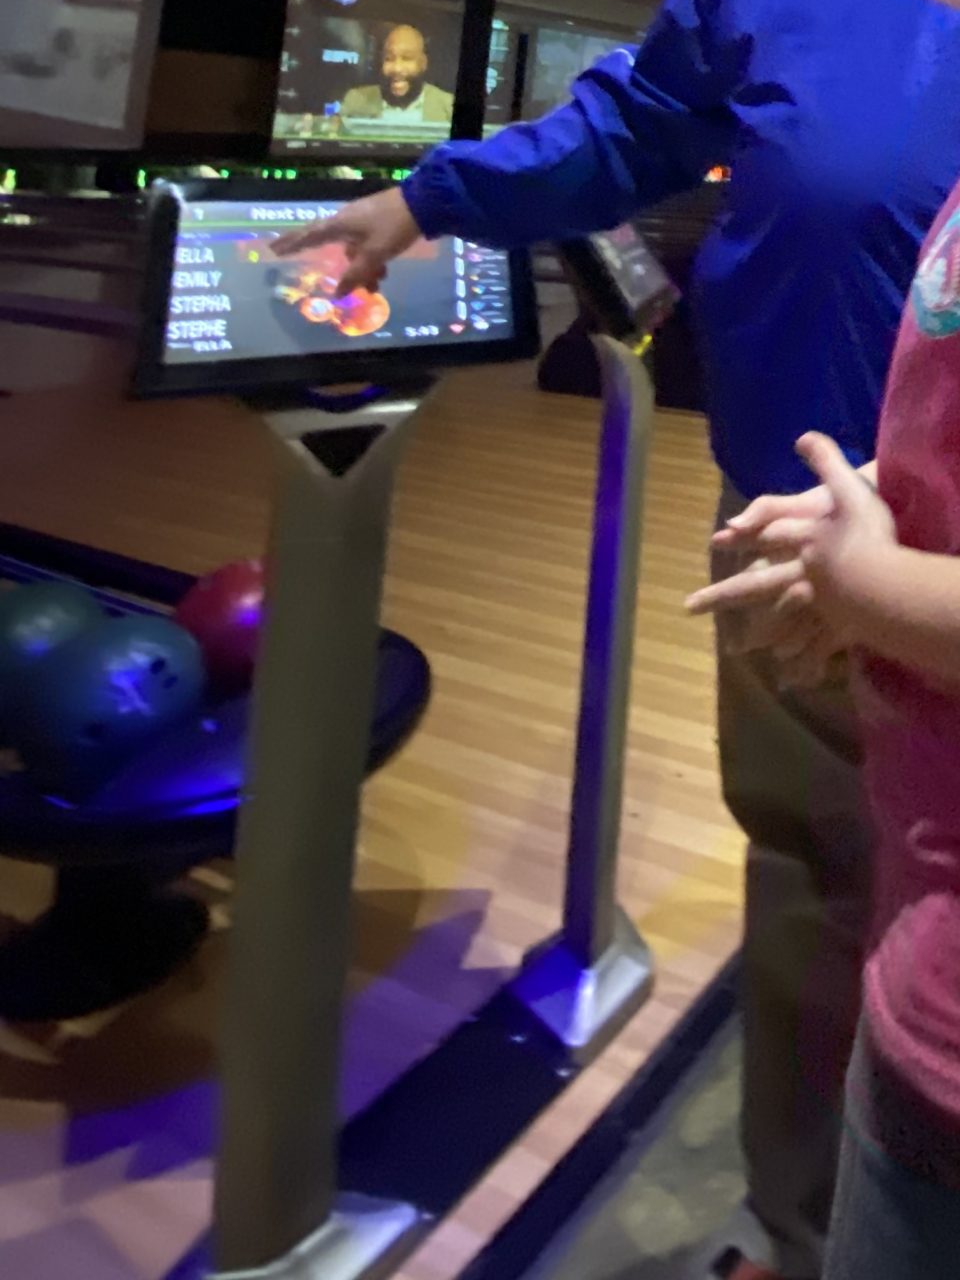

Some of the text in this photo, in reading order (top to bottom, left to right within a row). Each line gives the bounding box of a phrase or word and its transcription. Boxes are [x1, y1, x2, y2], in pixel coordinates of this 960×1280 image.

[251, 207, 296, 221] Next
[296, 206, 317, 221] to
[174, 246, 215, 264] ELLA
[172, 270, 222, 289] EMILY
[170, 294, 232, 314] STEPHA
[167, 318, 228, 340] STEPHE
